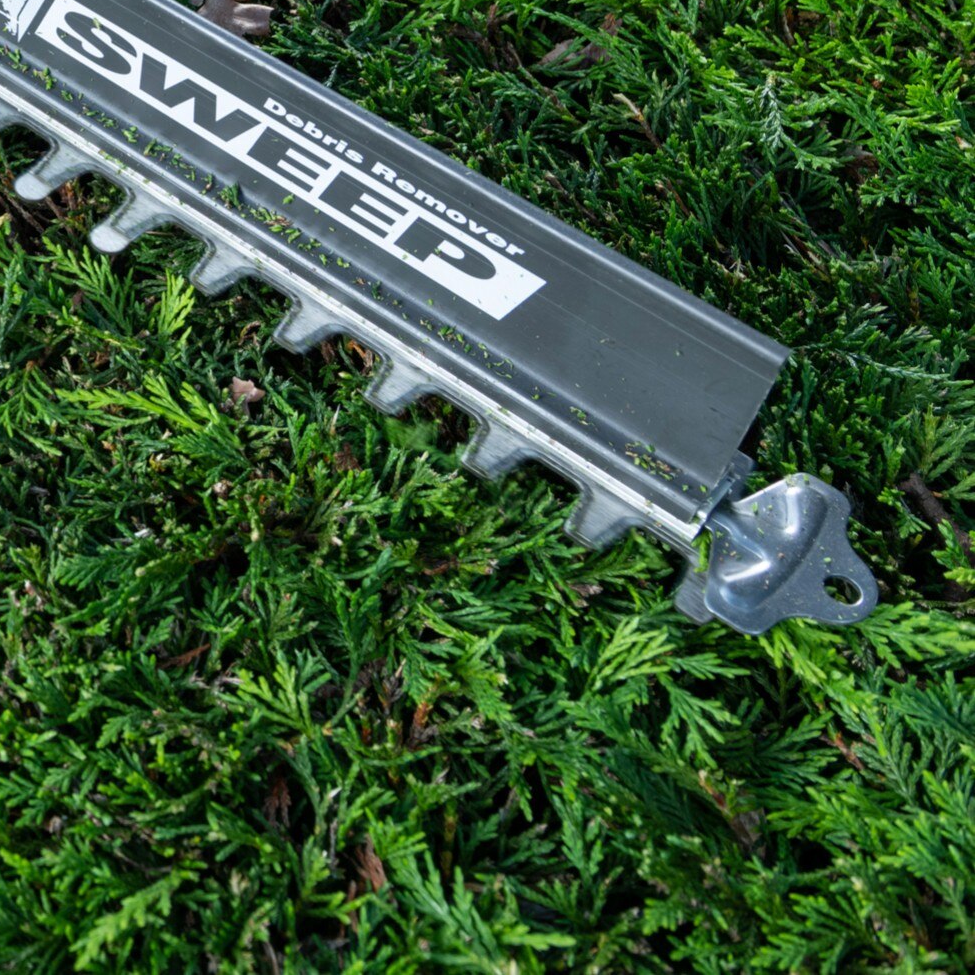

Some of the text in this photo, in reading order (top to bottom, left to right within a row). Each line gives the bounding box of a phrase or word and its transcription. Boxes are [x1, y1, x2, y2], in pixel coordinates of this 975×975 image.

[58, 11, 497, 280] SWEEP
[263, 97, 525, 257] Debris Remover
